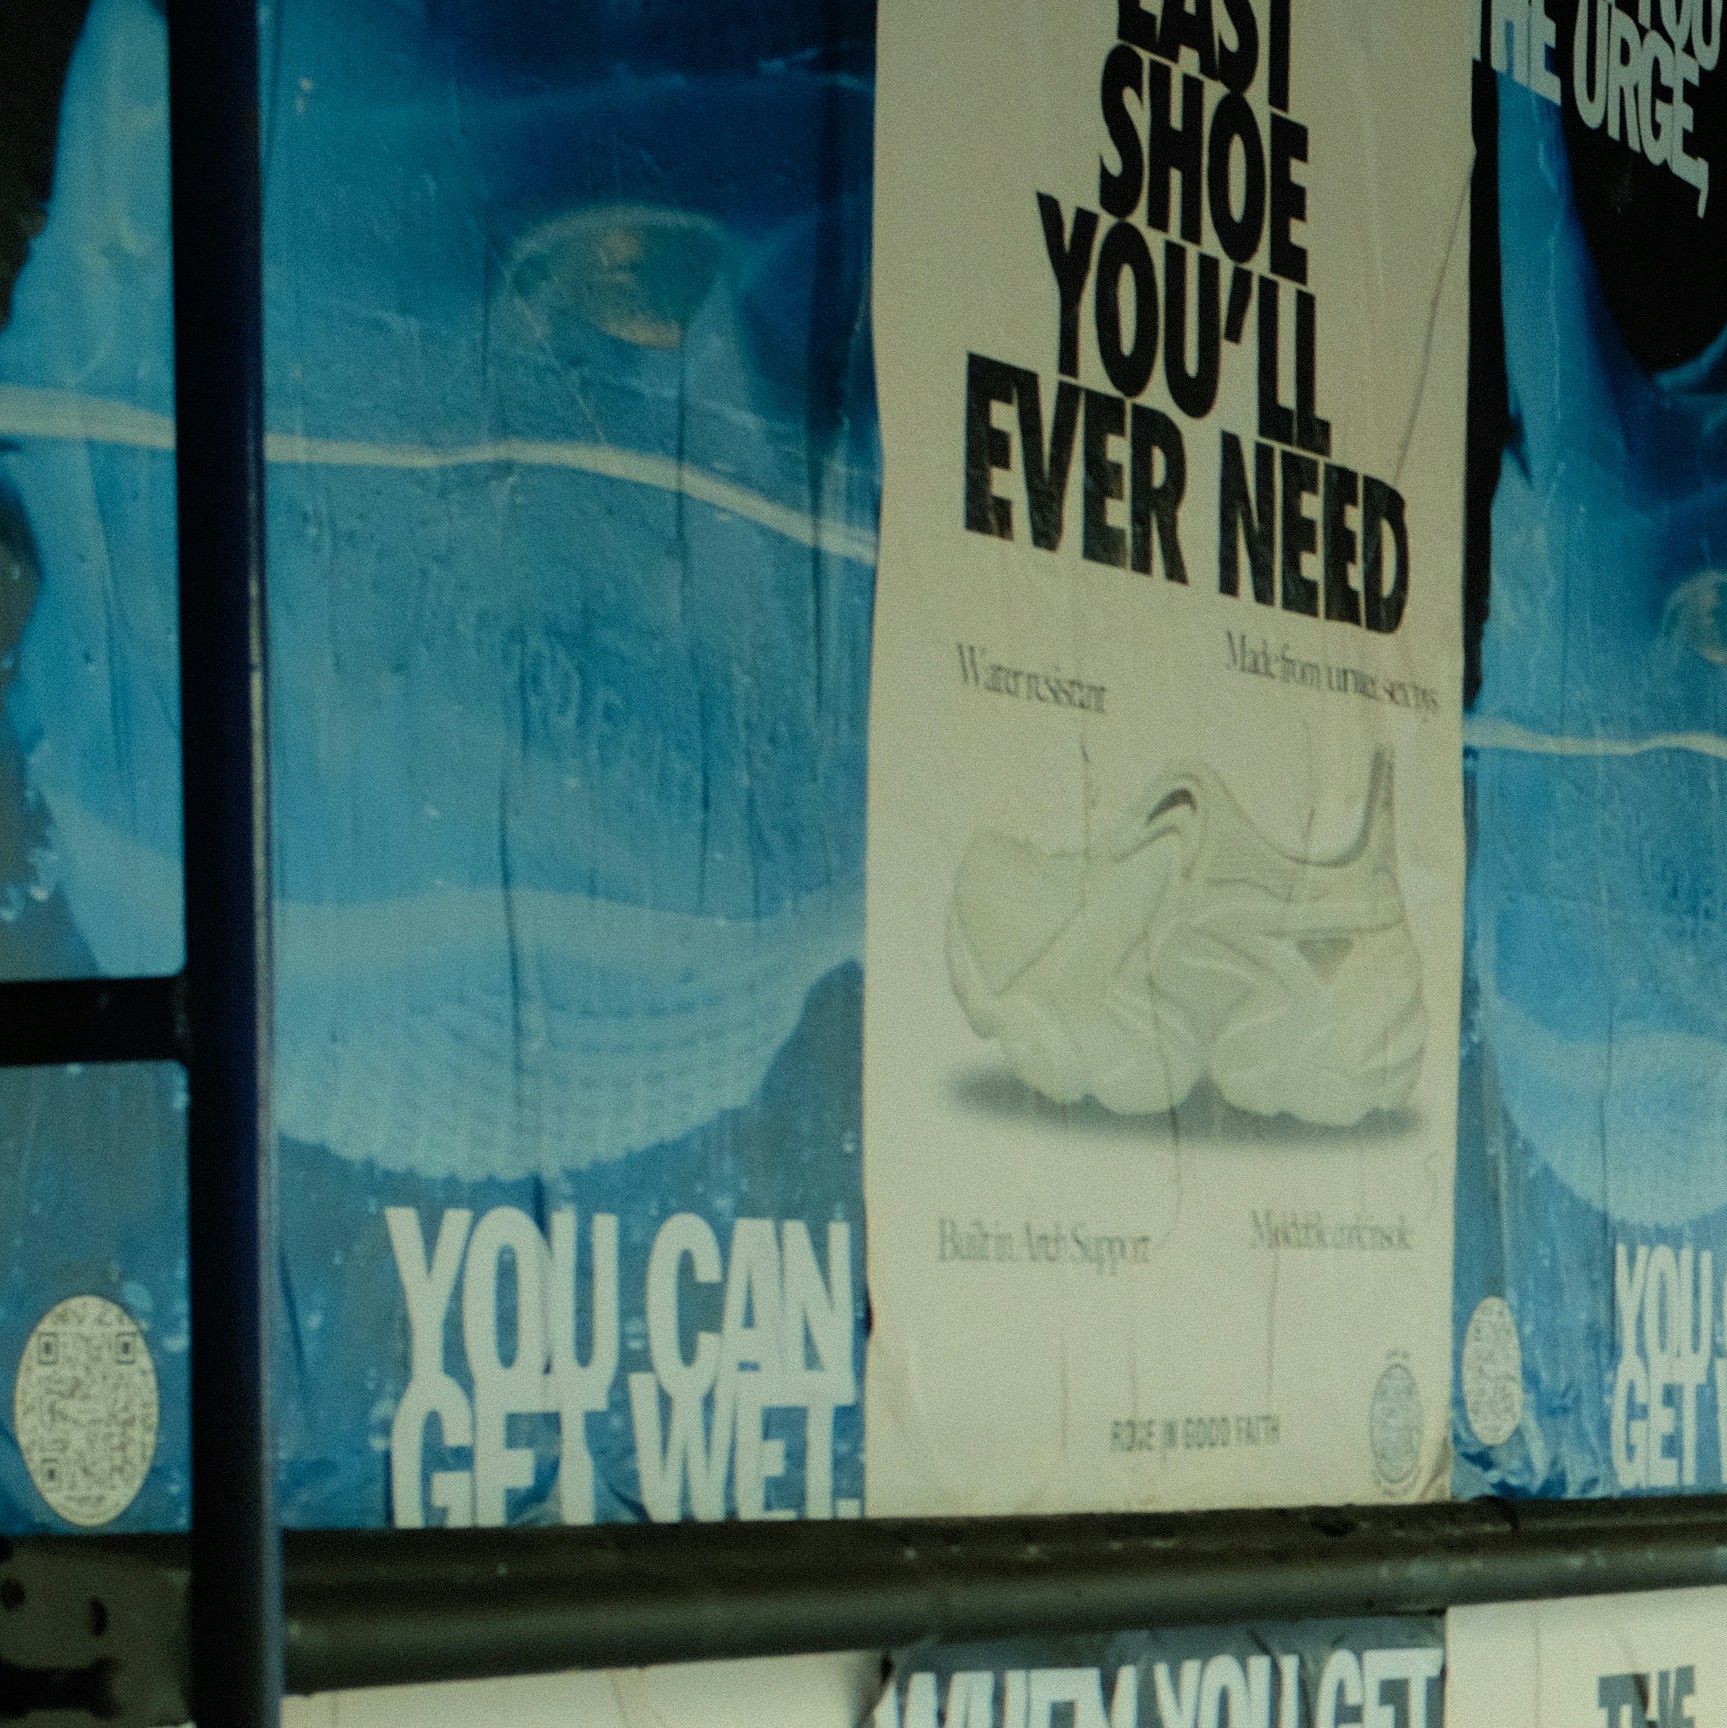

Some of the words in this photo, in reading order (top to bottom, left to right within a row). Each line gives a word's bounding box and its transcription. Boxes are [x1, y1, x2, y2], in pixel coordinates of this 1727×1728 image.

[1117, 0, 1290, 112] ST
[1573, 0, 1709, 219] URGE,
[1100, 44, 1308, 286] SHOE
[1036, 191, 1331, 457] YOU'LL
[965, 352, 1189, 587] EVER
[1219, 430, 1409, 634] NEED
[384, 1206, 620, 1392] YOU
[645, 1211, 855, 1400] CAN
[1614, 1243, 1713, 1366] YOU
[390, 1371, 609, 1528] GET
[627, 1372, 861, 1523] WET.
[1611, 1359, 1708, 1489] GET
